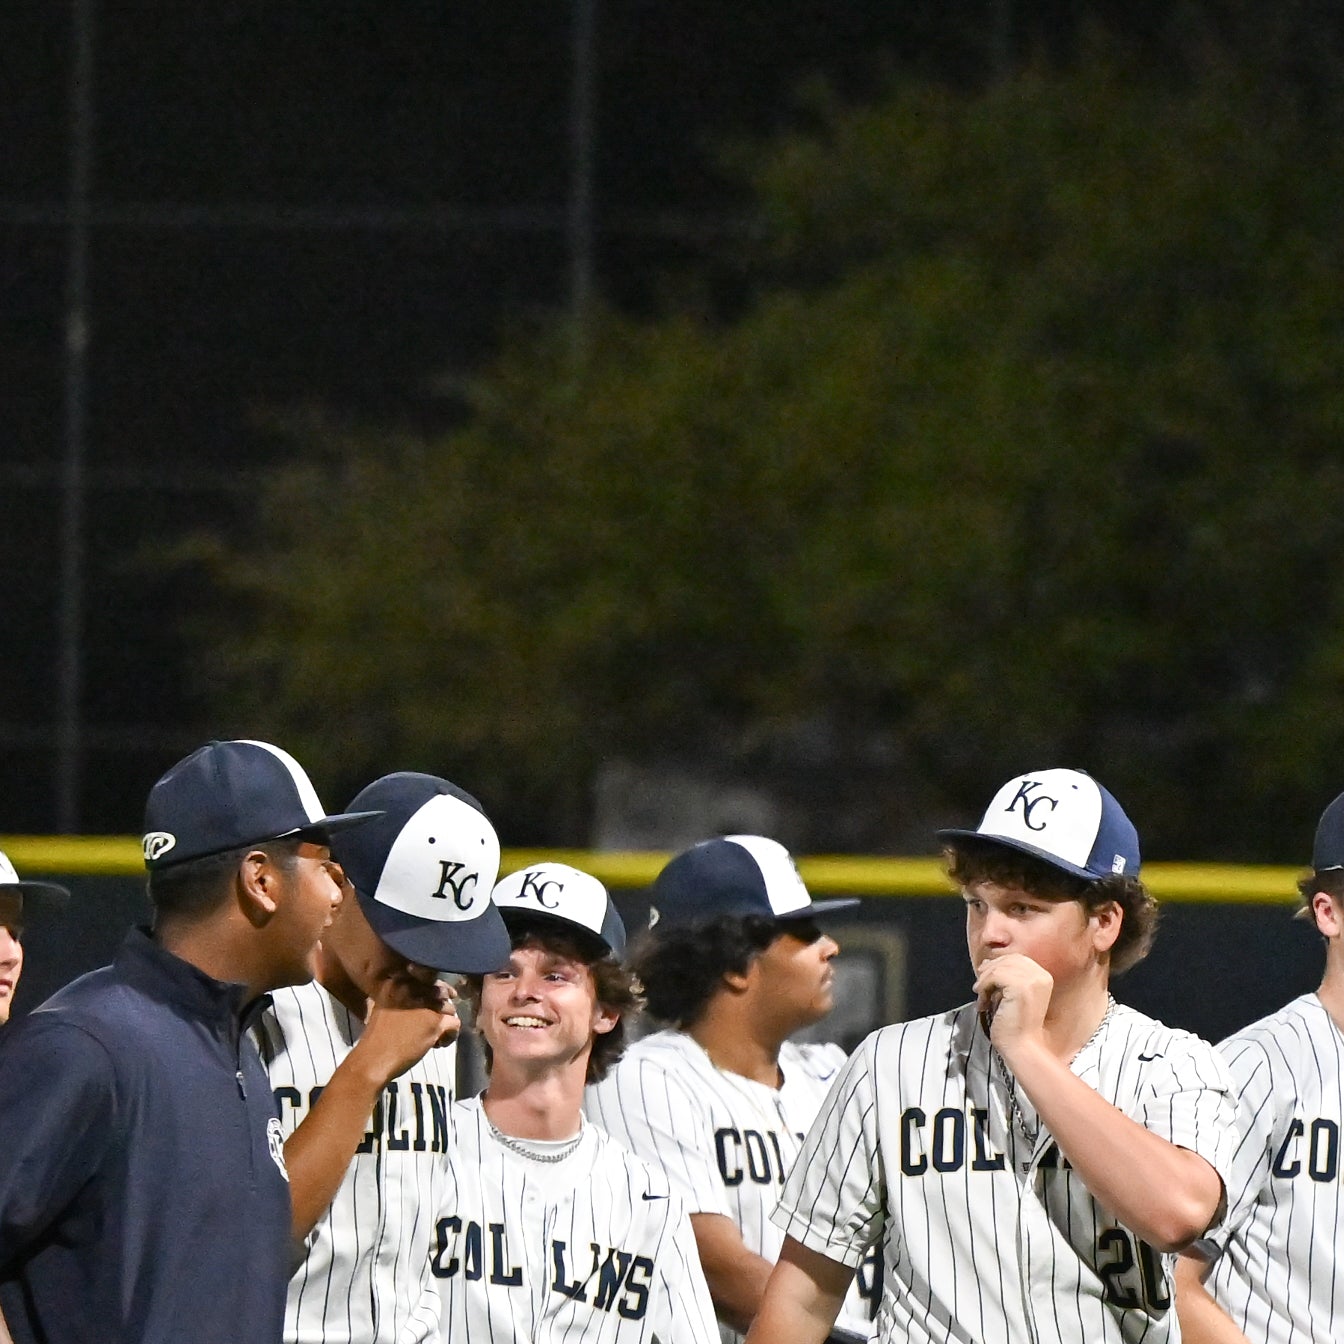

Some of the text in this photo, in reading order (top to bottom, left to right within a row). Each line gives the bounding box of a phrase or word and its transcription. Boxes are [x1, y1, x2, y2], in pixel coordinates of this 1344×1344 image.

[1004, 778, 1059, 831] KC
[432, 860, 479, 911] KC
[515, 871, 565, 909] KC
[431, 1214, 655, 1321] COLLINS
